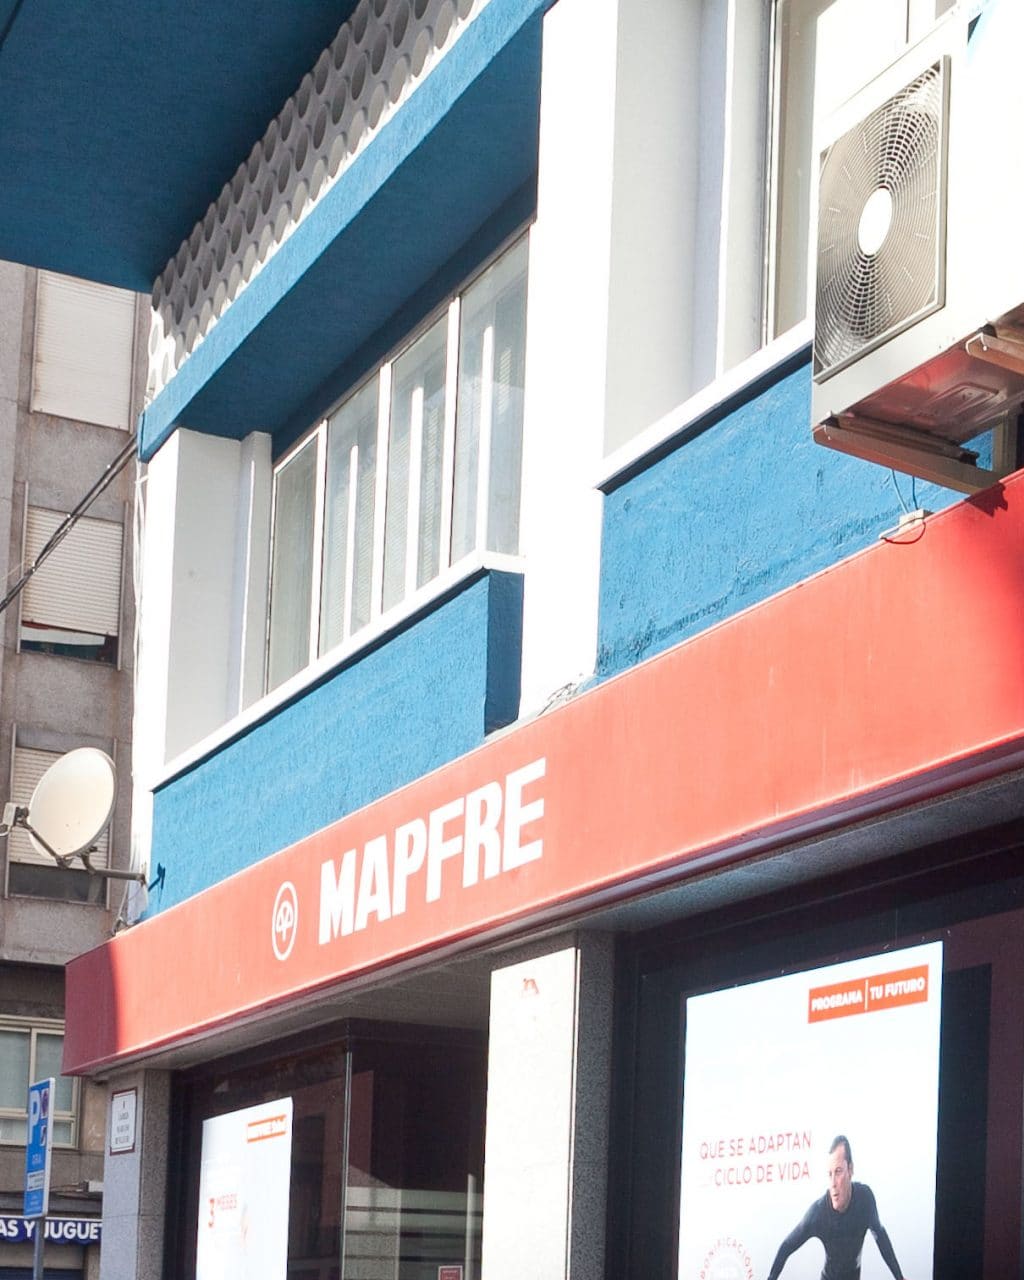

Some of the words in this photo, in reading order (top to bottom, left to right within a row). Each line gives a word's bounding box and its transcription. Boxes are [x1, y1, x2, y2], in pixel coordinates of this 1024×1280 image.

[318, 756, 546, 945] MAPFRE
[869, 986, 883, 1000] TU
[885, 977, 925, 998] FUTURO
[29, 1090, 41, 1145] P
[699, 1140, 725, 1160] QUE
[729, 1138, 744, 1157] SE
[749, 1131, 812, 1154] ADAPTAN
[714, 1165, 752, 1187] CICLO
[756, 1164, 773, 1183] DE
[778, 1161, 810, 1181] VIDA
[23, 1220, 36, 1238] Y
